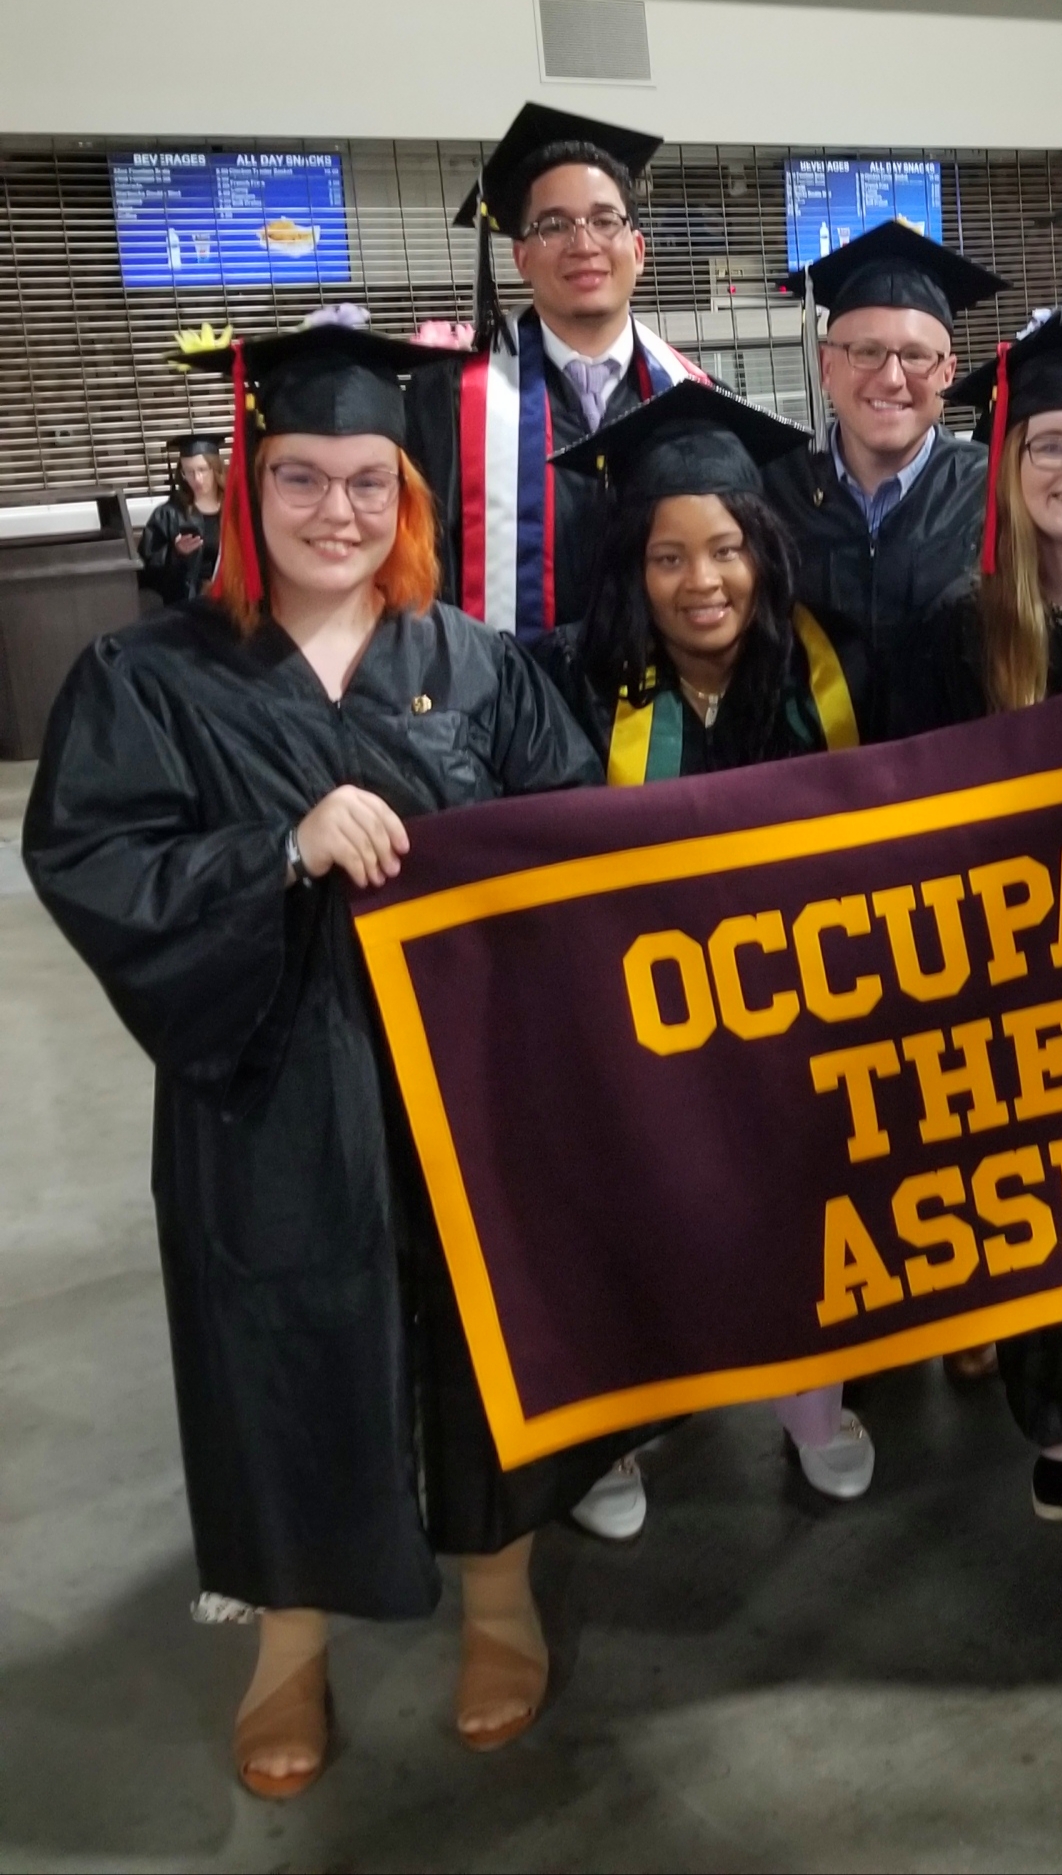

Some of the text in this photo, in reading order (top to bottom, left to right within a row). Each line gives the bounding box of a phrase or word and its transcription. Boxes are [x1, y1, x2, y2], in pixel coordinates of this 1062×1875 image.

[237, 154, 257, 167] ALL
[260, 154, 284, 167] DAY
[870, 161, 884, 174] ALL
